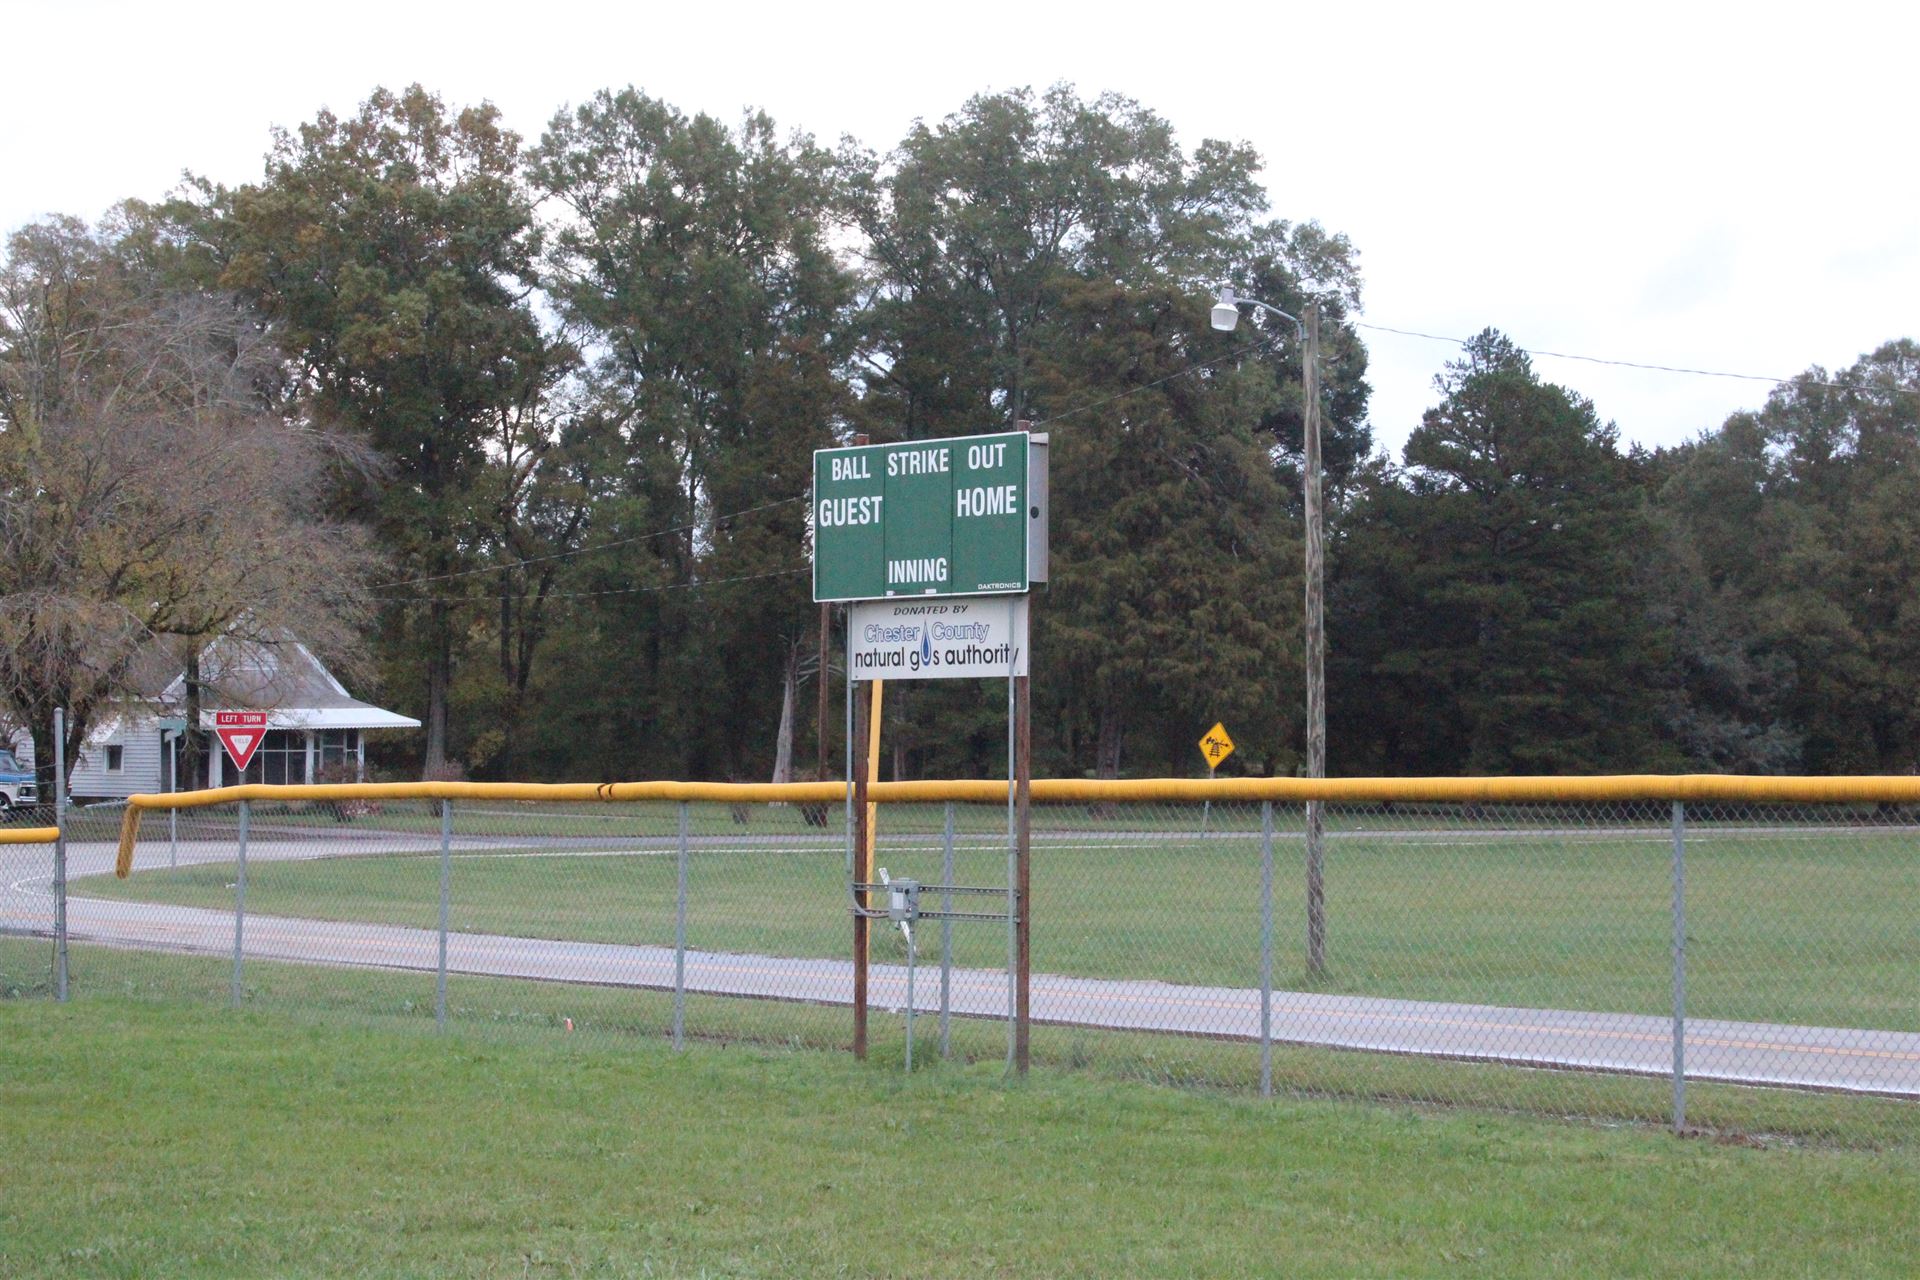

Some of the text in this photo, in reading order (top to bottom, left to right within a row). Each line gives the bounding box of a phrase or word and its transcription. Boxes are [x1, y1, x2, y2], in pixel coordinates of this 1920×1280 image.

[832, 443, 1007, 481] BALL STRIKE OUT
[819, 485, 1017, 527] GUEST HOME
[888, 557, 947, 584] INNING
[893, 604, 969, 616] DONATED BY
[865, 621, 990, 643] Chester County
[855, 647, 905, 668] natural
[221, 715, 262, 723] LEFT TURN
